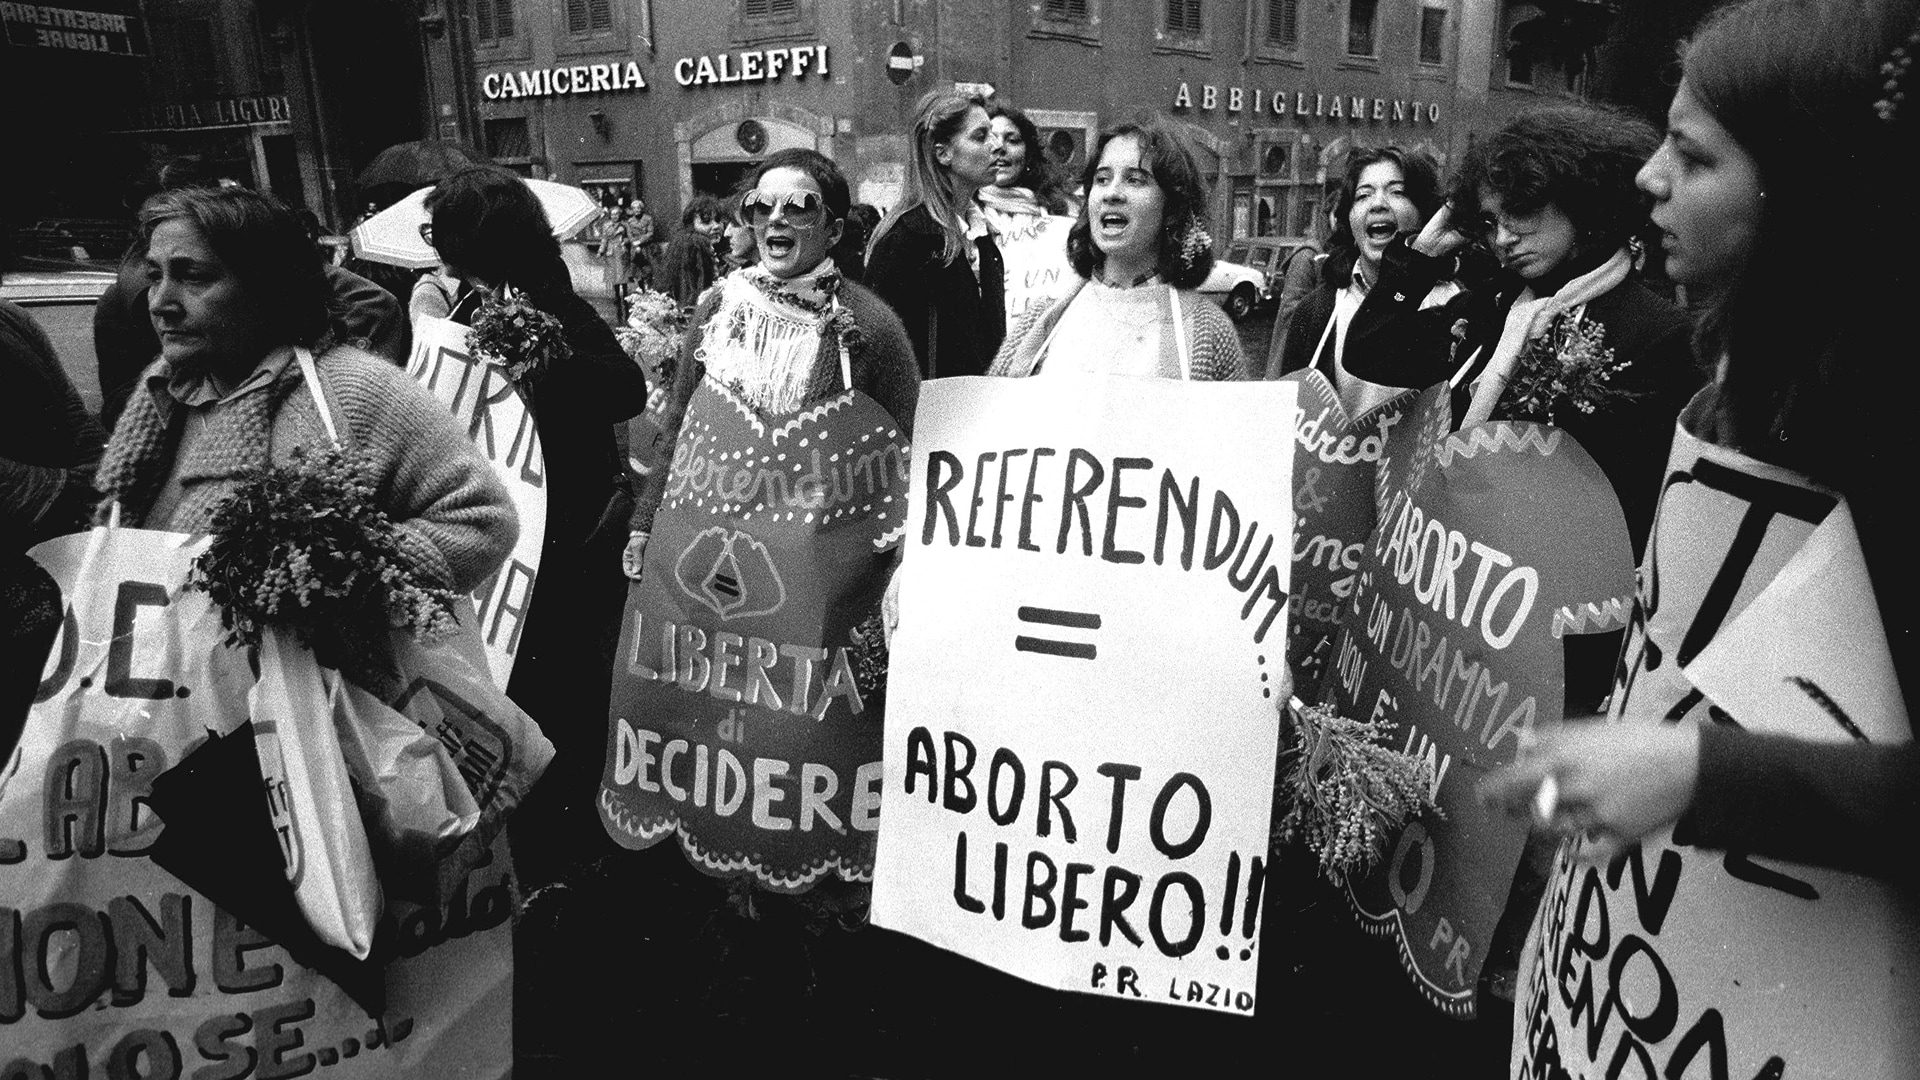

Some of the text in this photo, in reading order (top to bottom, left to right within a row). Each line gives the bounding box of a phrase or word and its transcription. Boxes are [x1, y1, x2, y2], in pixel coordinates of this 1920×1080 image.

[483, 45, 829, 99] CAMICERIA CALEFFI
[1174, 82, 1440, 123] ABBIGLIAMENTO
[1367, 592, 1394, 655] UN
[1389, 606, 1537, 750] DRAMMA
[717, 707, 746, 744] di
[614, 718, 883, 836] DECIDERE
[903, 726, 1213, 860] ABORTO
[953, 830, 1267, 962] LIBERO!!
[1169, 977, 1254, 1012] LAZIO
